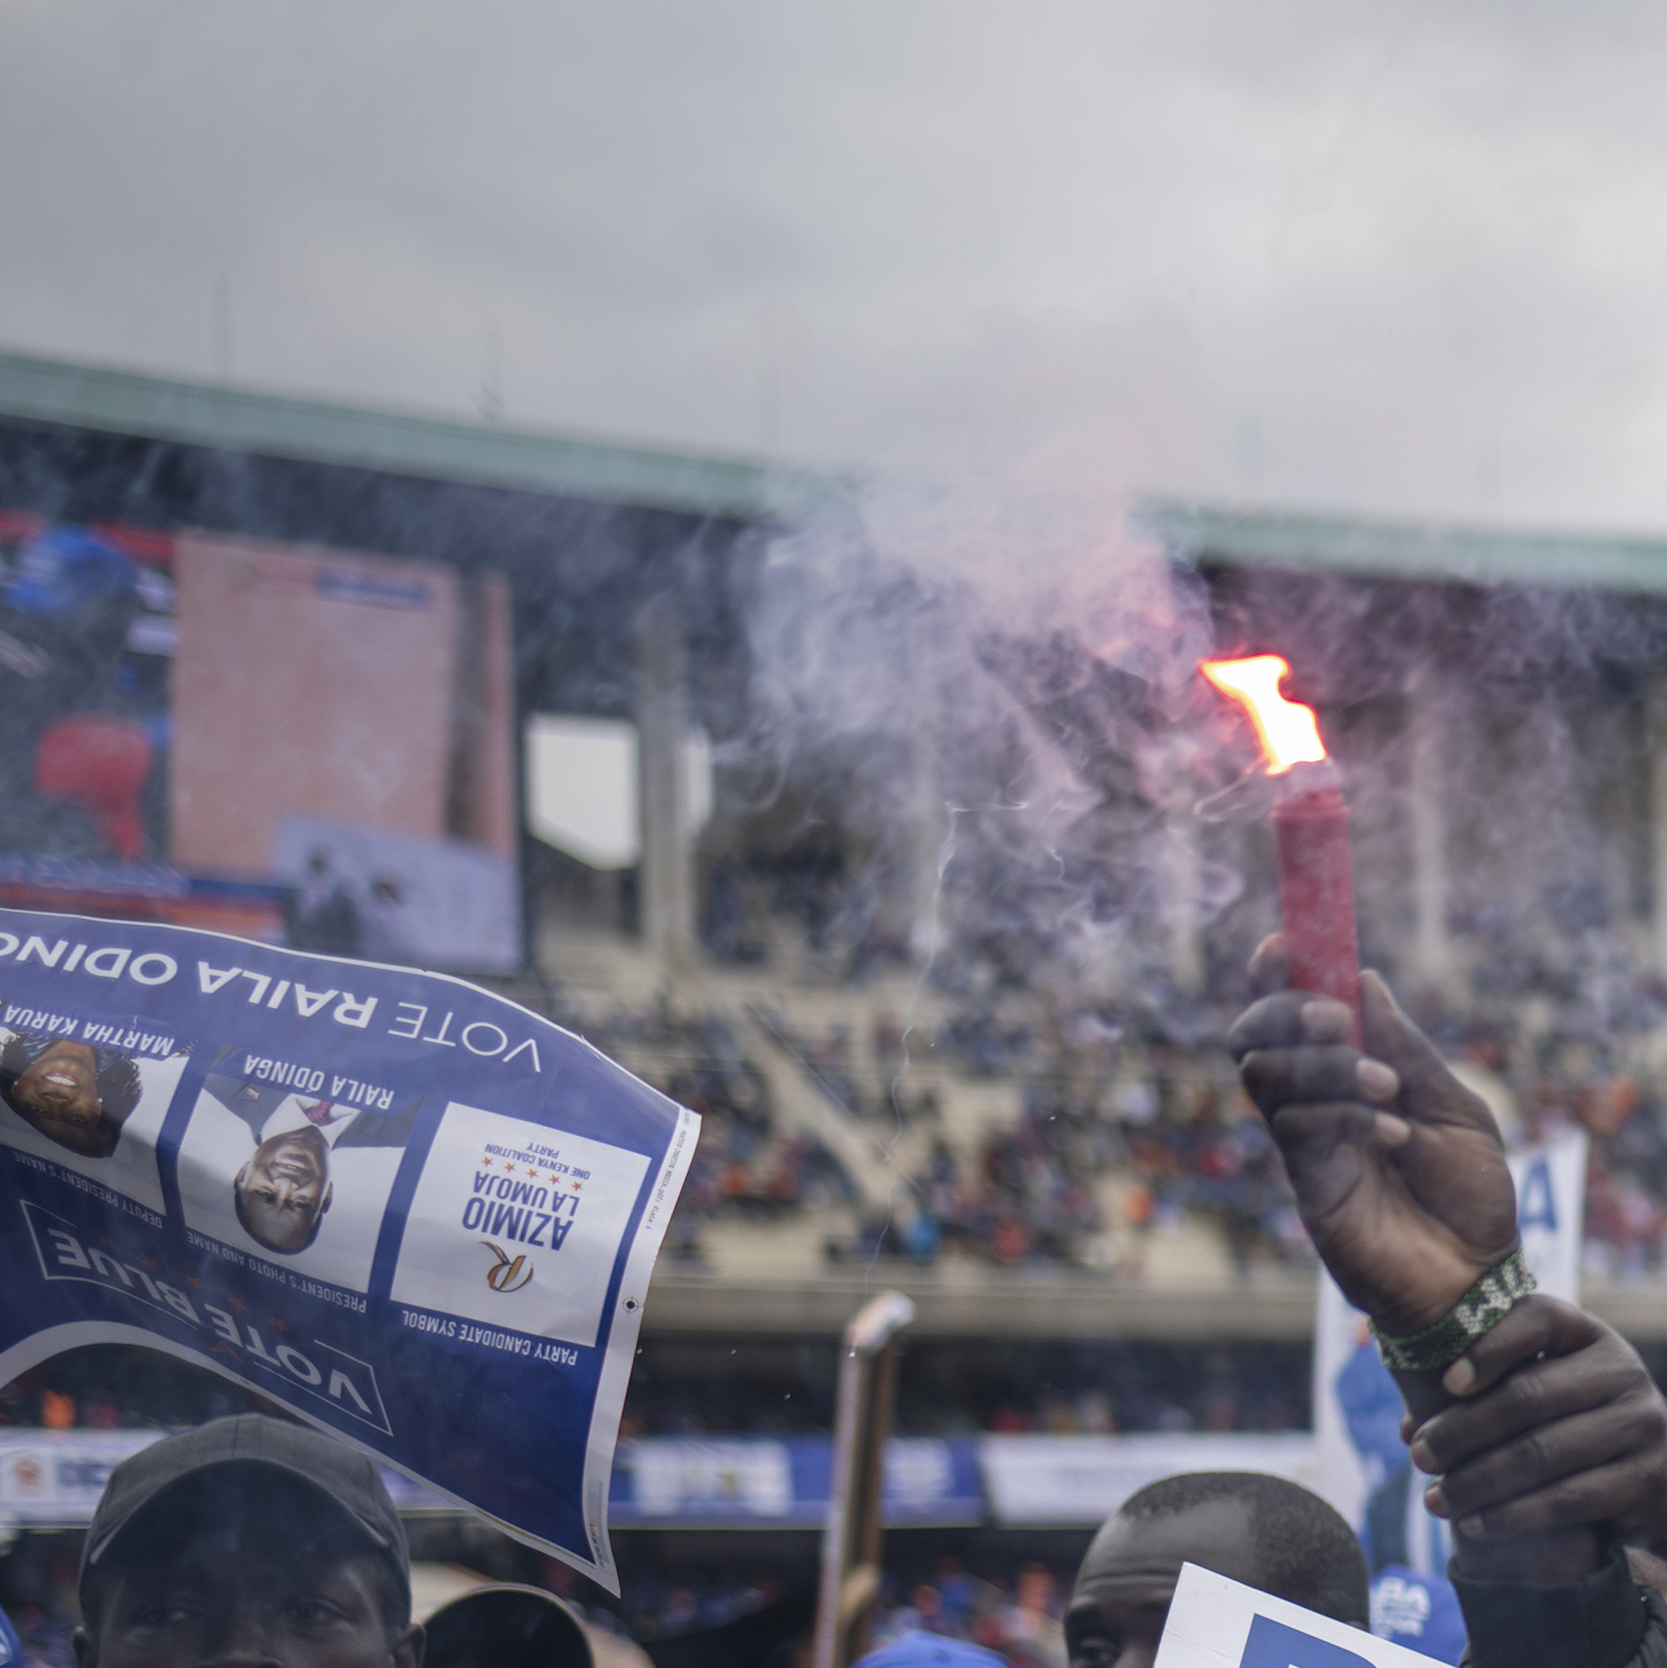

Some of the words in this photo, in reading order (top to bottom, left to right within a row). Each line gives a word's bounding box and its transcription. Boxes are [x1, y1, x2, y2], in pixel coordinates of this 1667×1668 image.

[198, 961, 379, 1028] RAILA
[3, 1004, 79, 1036] KARUA
[82, 1021, 176, 1057] MARTHA
[388, 1002, 541, 1073] VOTE
[330, 1075, 395, 1110] RAILA
[484, 1143, 538, 1166] COALITION
[526, 1141, 560, 1160] PARTY
[540, 1158, 573, 1177] KENYA
[572, 1167, 592, 1181] ONE
[472, 1169, 548, 1214] UMOJA
[549, 1191, 581, 1217] LA
[120, 1198, 164, 1230] DEPUTY
[462, 1198, 575, 1252] AZIMIO
[186, 1230, 219, 1256] NAME
[221, 1247, 246, 1268] AND
[47, 1227, 202, 1325] BLUE
[248, 1259, 288, 1290] PHOTO
[402, 1309, 457, 1338] SYMBOL
[458, 1324, 535, 1359] CANDIDATE
[537, 1344, 578, 1367] PARTY
[202, 1302, 373, 1416] VOTE
